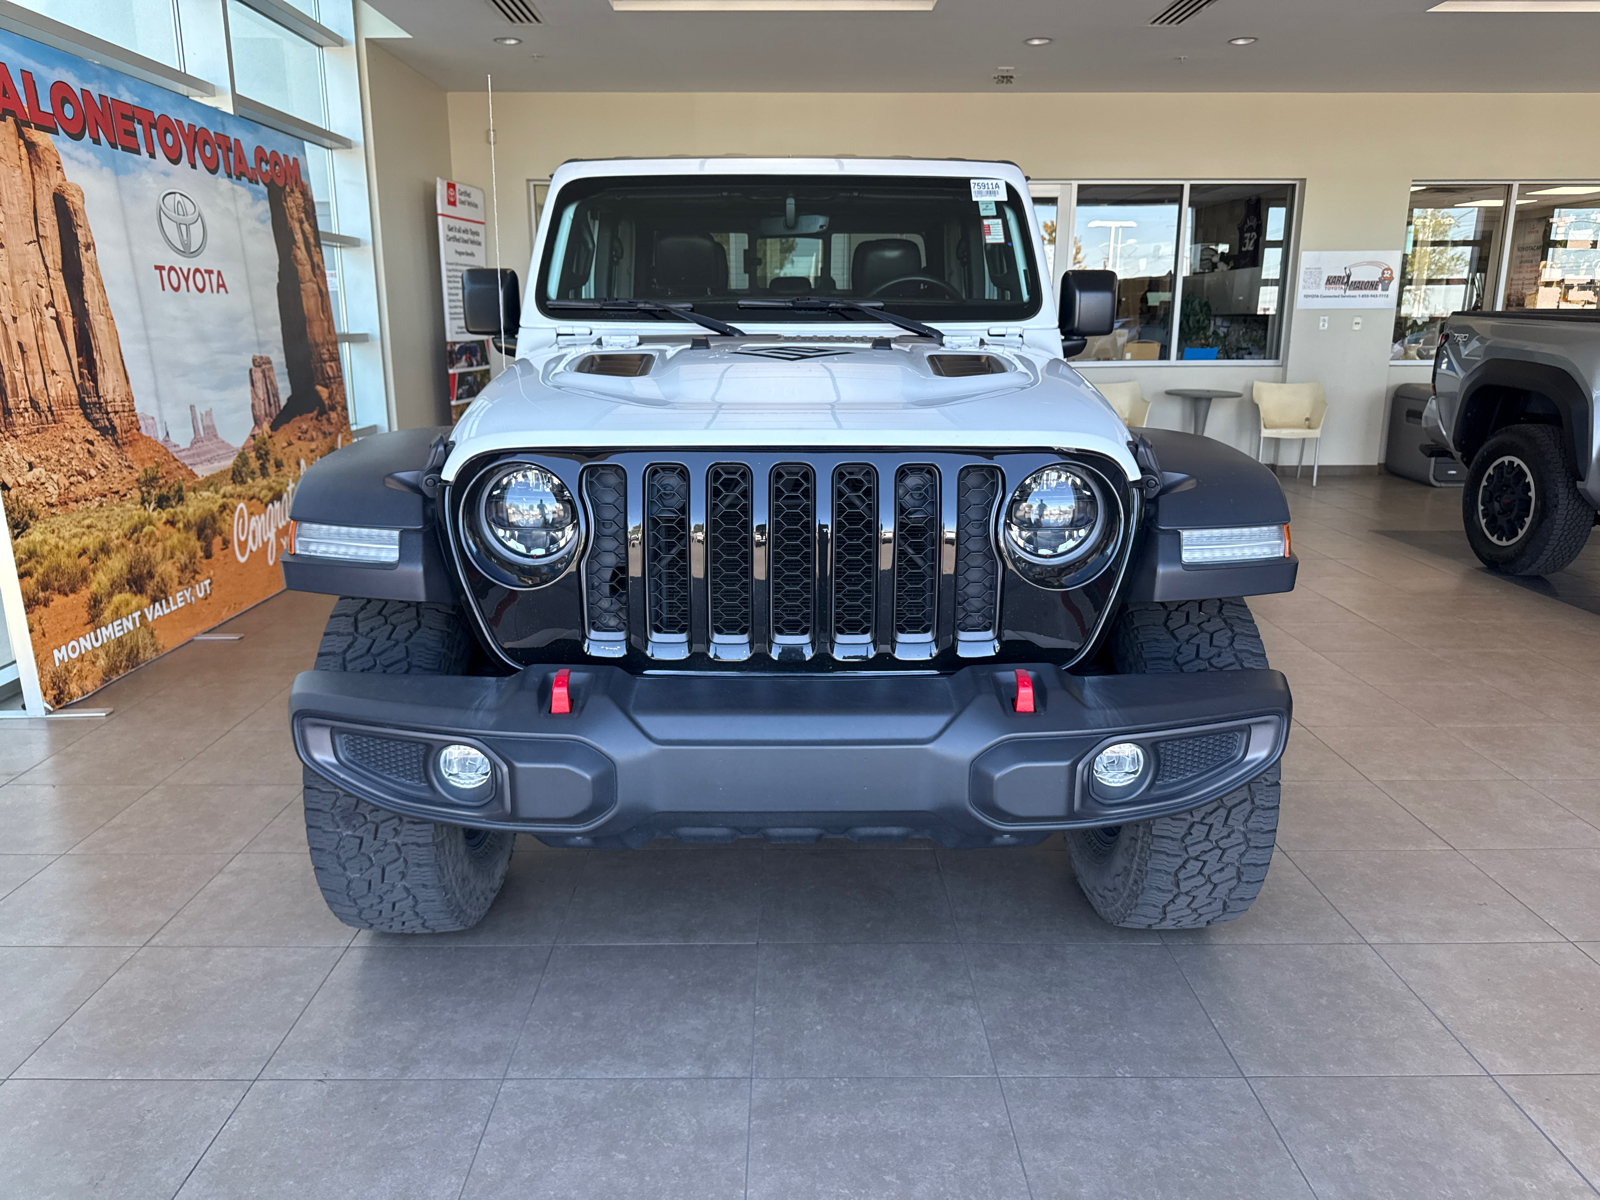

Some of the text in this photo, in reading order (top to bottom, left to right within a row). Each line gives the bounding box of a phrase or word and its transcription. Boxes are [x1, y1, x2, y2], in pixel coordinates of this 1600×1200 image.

[972, 182, 1000, 190] 75911A
[1241, 232, 1257, 251] 32
[153, 264, 229, 294] TOYOTA
[1325, 275, 1380, 291] KARL MALONE
[1453, 333, 1469, 343] TRD
[52, 578, 211, 667] MONUMENT VALLEY, UT
